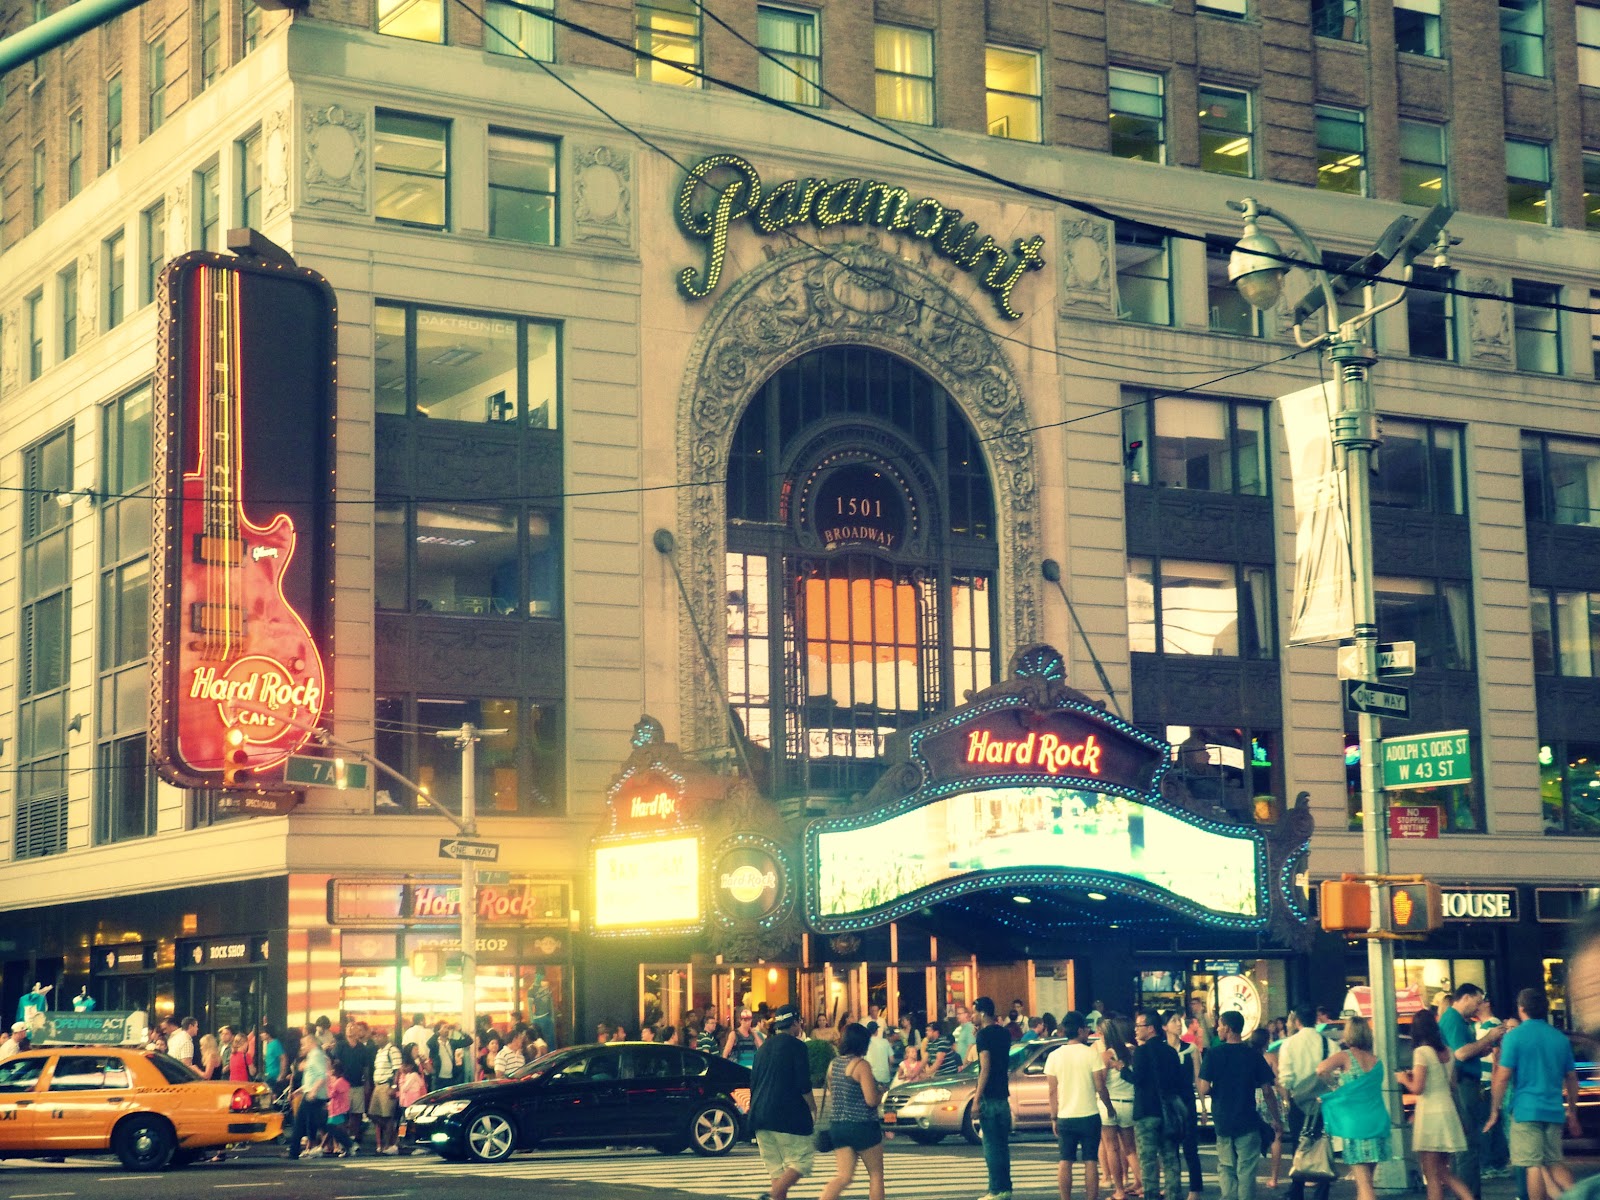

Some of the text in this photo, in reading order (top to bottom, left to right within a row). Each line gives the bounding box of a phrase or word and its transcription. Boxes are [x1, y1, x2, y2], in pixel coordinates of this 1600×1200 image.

[674, 153, 1046, 321] Paramount
[418, 314, 515, 334] DAKTRONICS
[836, 496, 881, 518] 1501
[824, 526, 895, 546] BROADWAY
[1380, 653, 1404, 666] WAY
[190, 666, 320, 714] Hard Rock
[1356, 689, 1404, 709] ONE WAY
[238, 711, 276, 727] CAFE
[967, 730, 1101, 774] Hard Rock
[1386, 738, 1467, 762] ADOLPH S. OCHS ST
[312, 763, 337, 781] 7 A
[1399, 760, 1455, 781] W 43 ST
[630, 791, 676, 820] Hard Roc
[1406, 808, 1420, 817] NO
[1396, 816, 1430, 824] STOPPING
[1399, 824, 1429, 832] ANYTIME
[449, 844, 493, 857] ONE WAY
[485, 871, 492, 883] 7
[746, 871, 776, 889] Rock
[414, 883, 537, 921] Har Rock
[209, 944, 246, 959] ROCK SHOP
[475, 938, 508, 951] HOP
[53, 1018, 126, 1029] OPENING ACT
[0, 1109, 17, 1120] XI
